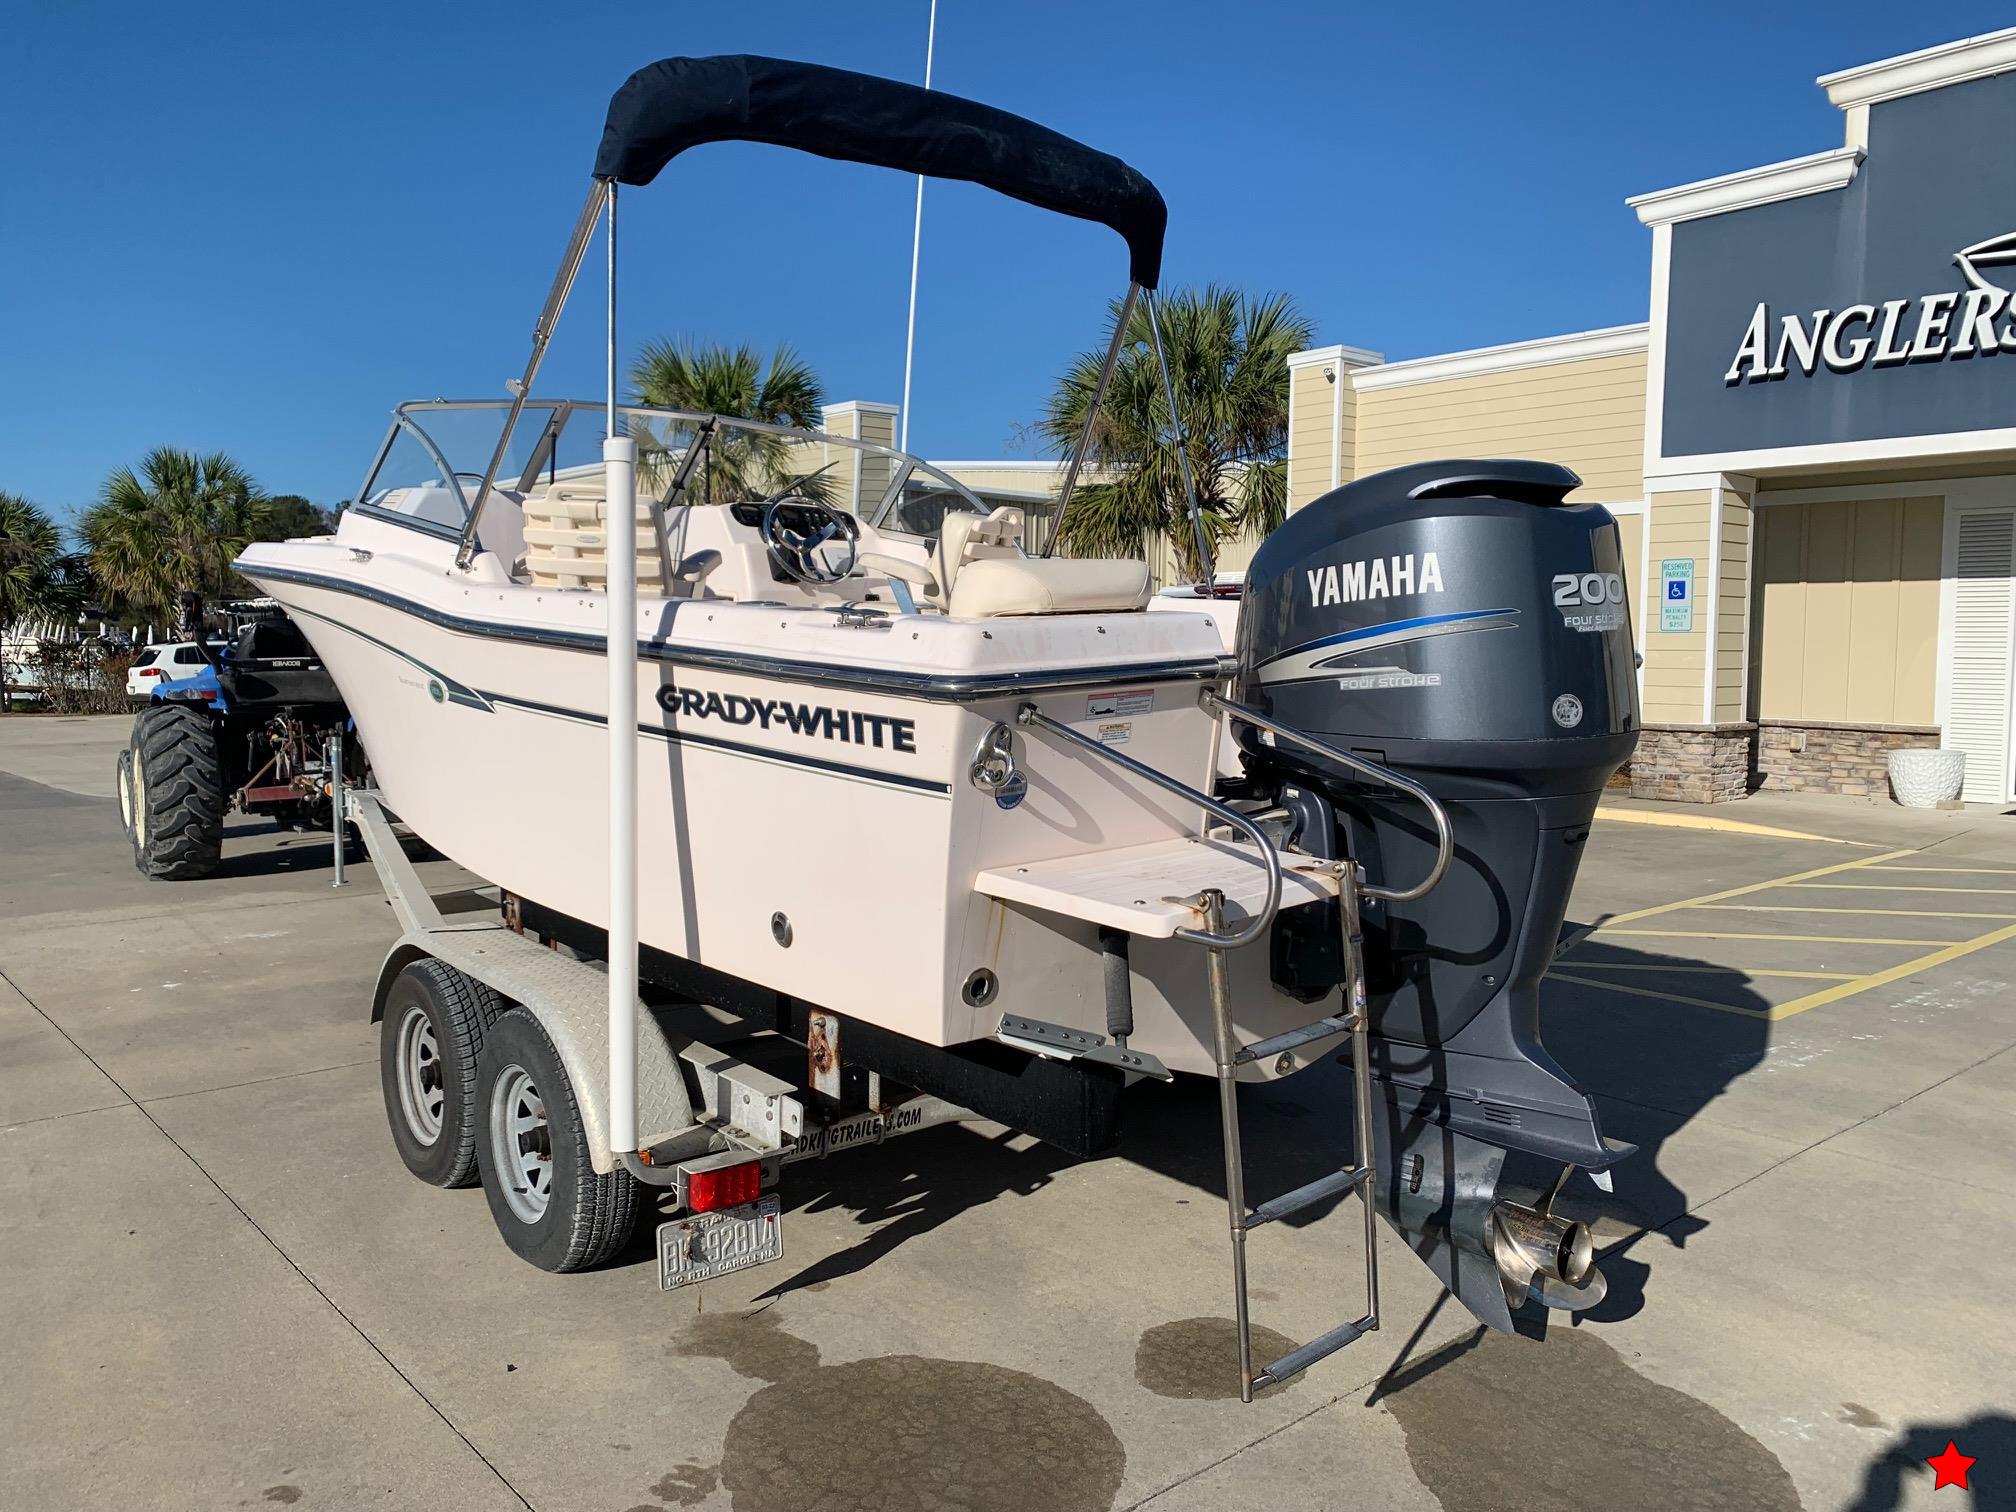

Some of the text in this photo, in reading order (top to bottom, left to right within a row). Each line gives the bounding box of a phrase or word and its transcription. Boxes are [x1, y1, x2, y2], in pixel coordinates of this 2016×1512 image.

[1307, 552, 1444, 608] YAMAHA
[1663, 562, 1692, 571] RESERVED
[1665, 570, 1690, 578] PARKING
[1552, 574, 1623, 606] 200
[655, 683, 917, 754] GRADY-WHITE
